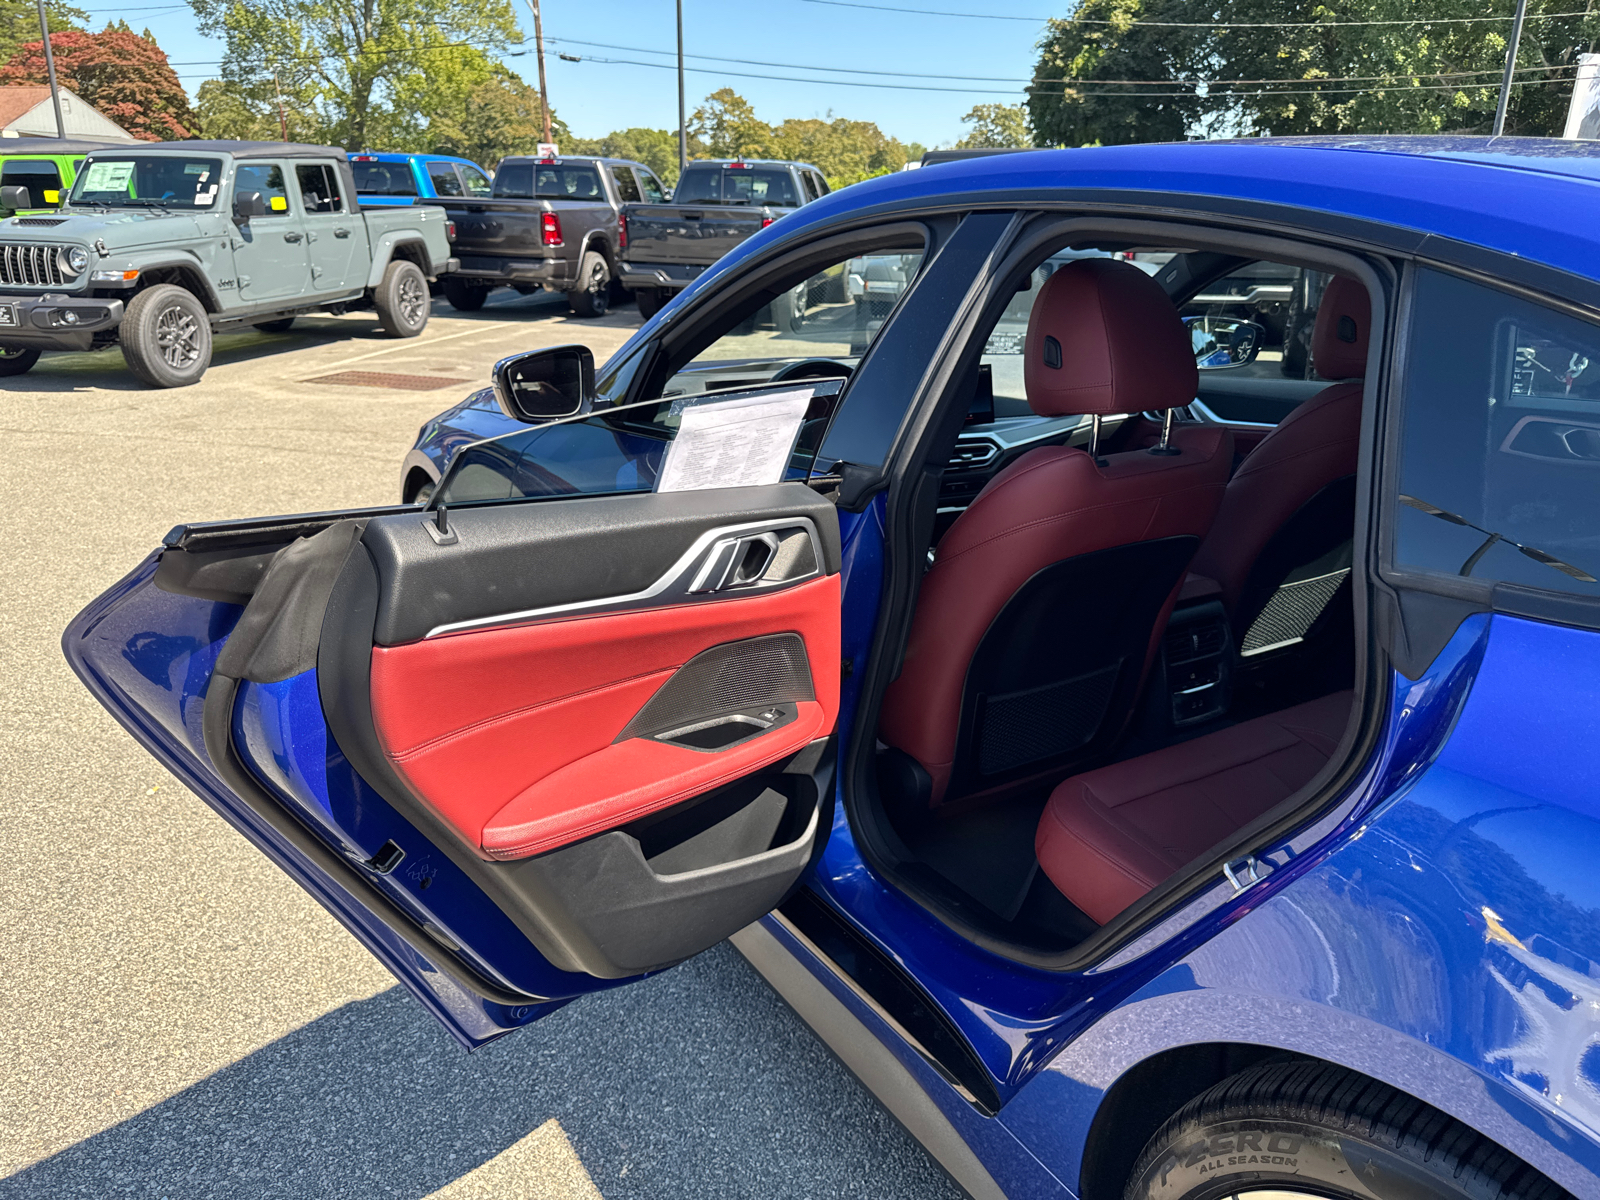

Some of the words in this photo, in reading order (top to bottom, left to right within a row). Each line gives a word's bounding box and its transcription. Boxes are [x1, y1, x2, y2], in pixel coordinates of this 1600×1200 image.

[1160, 1155, 1177, 1188] P
[1184, 1130, 1302, 1169] ZERO
[1199, 1161, 1225, 1175] ALL
[1227, 1154, 1299, 1167] SEASON
